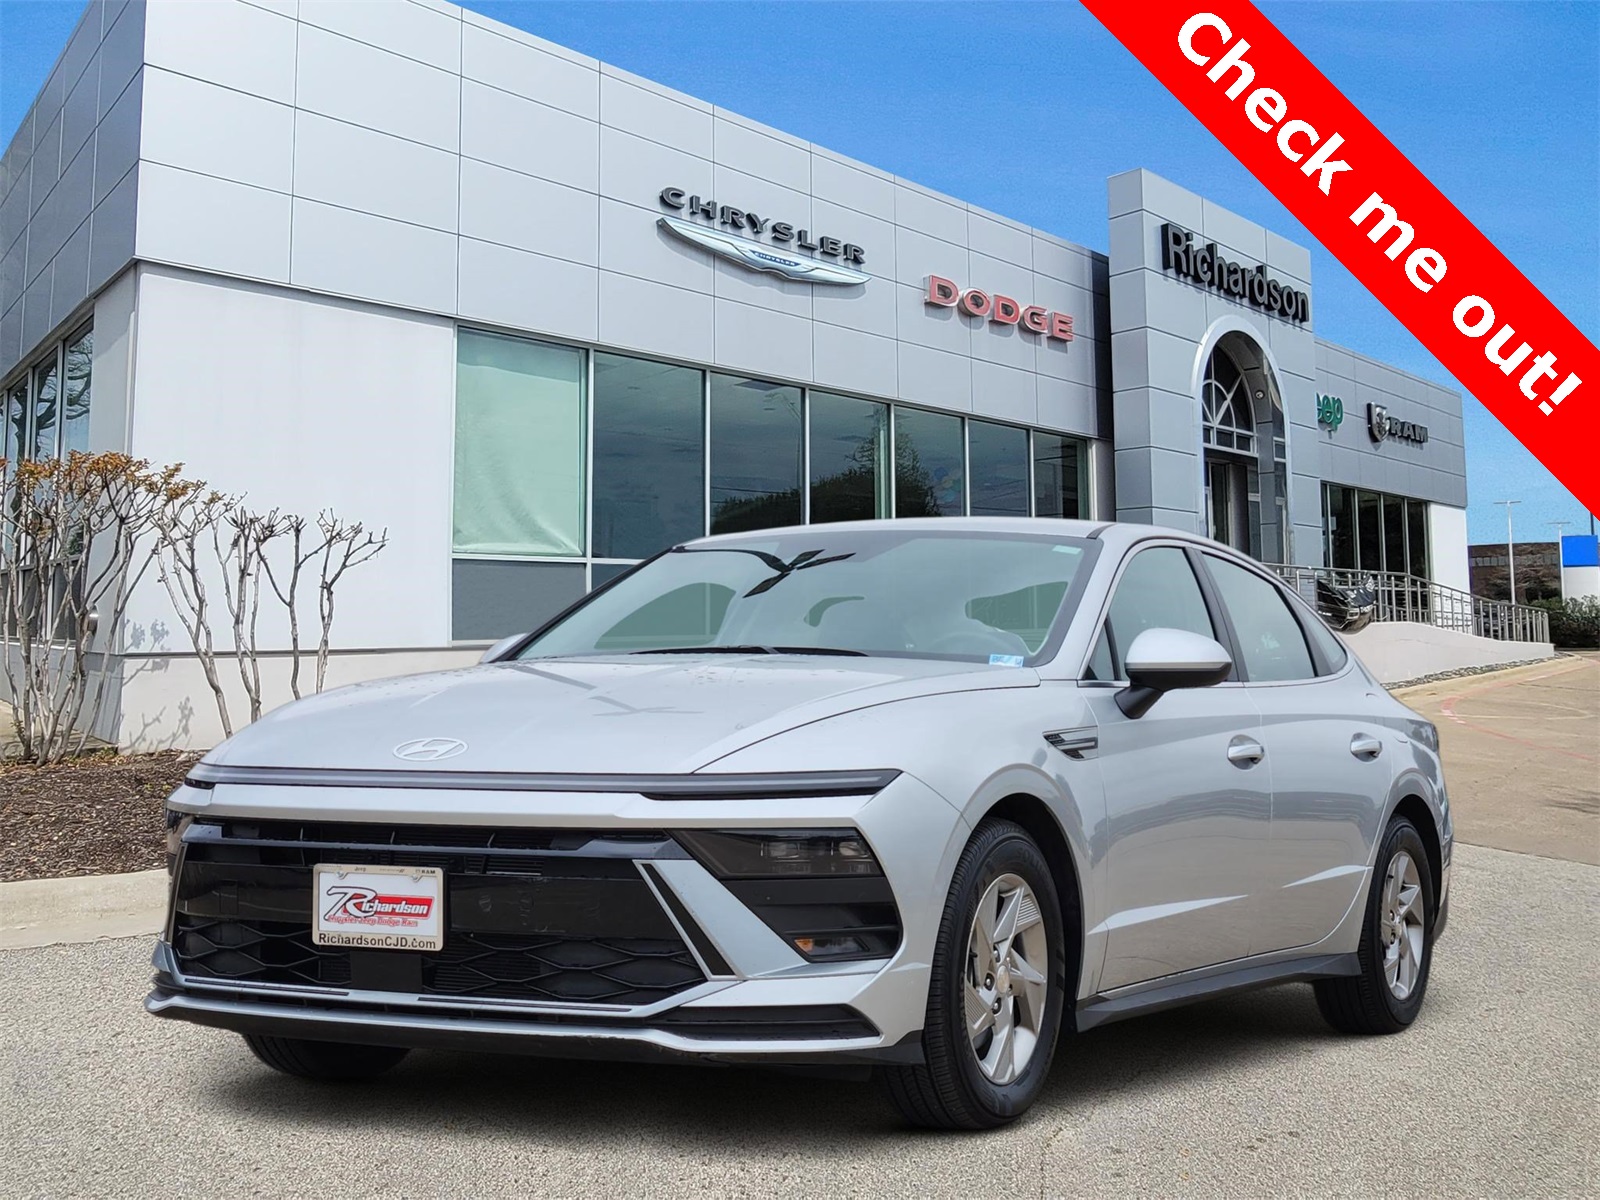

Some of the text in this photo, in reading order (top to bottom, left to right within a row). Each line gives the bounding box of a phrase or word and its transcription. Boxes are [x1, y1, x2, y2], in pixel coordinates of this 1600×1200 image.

[659, 186, 866, 264] CHRYSLER
[1162, 223, 1311, 323] Richardson
[924, 274, 1074, 341] DODGE
[1387, 416, 1429, 443] RAM
[324, 886, 429, 922] Richardson
[318, 932, 436, 950] RichardsonCJD.com
